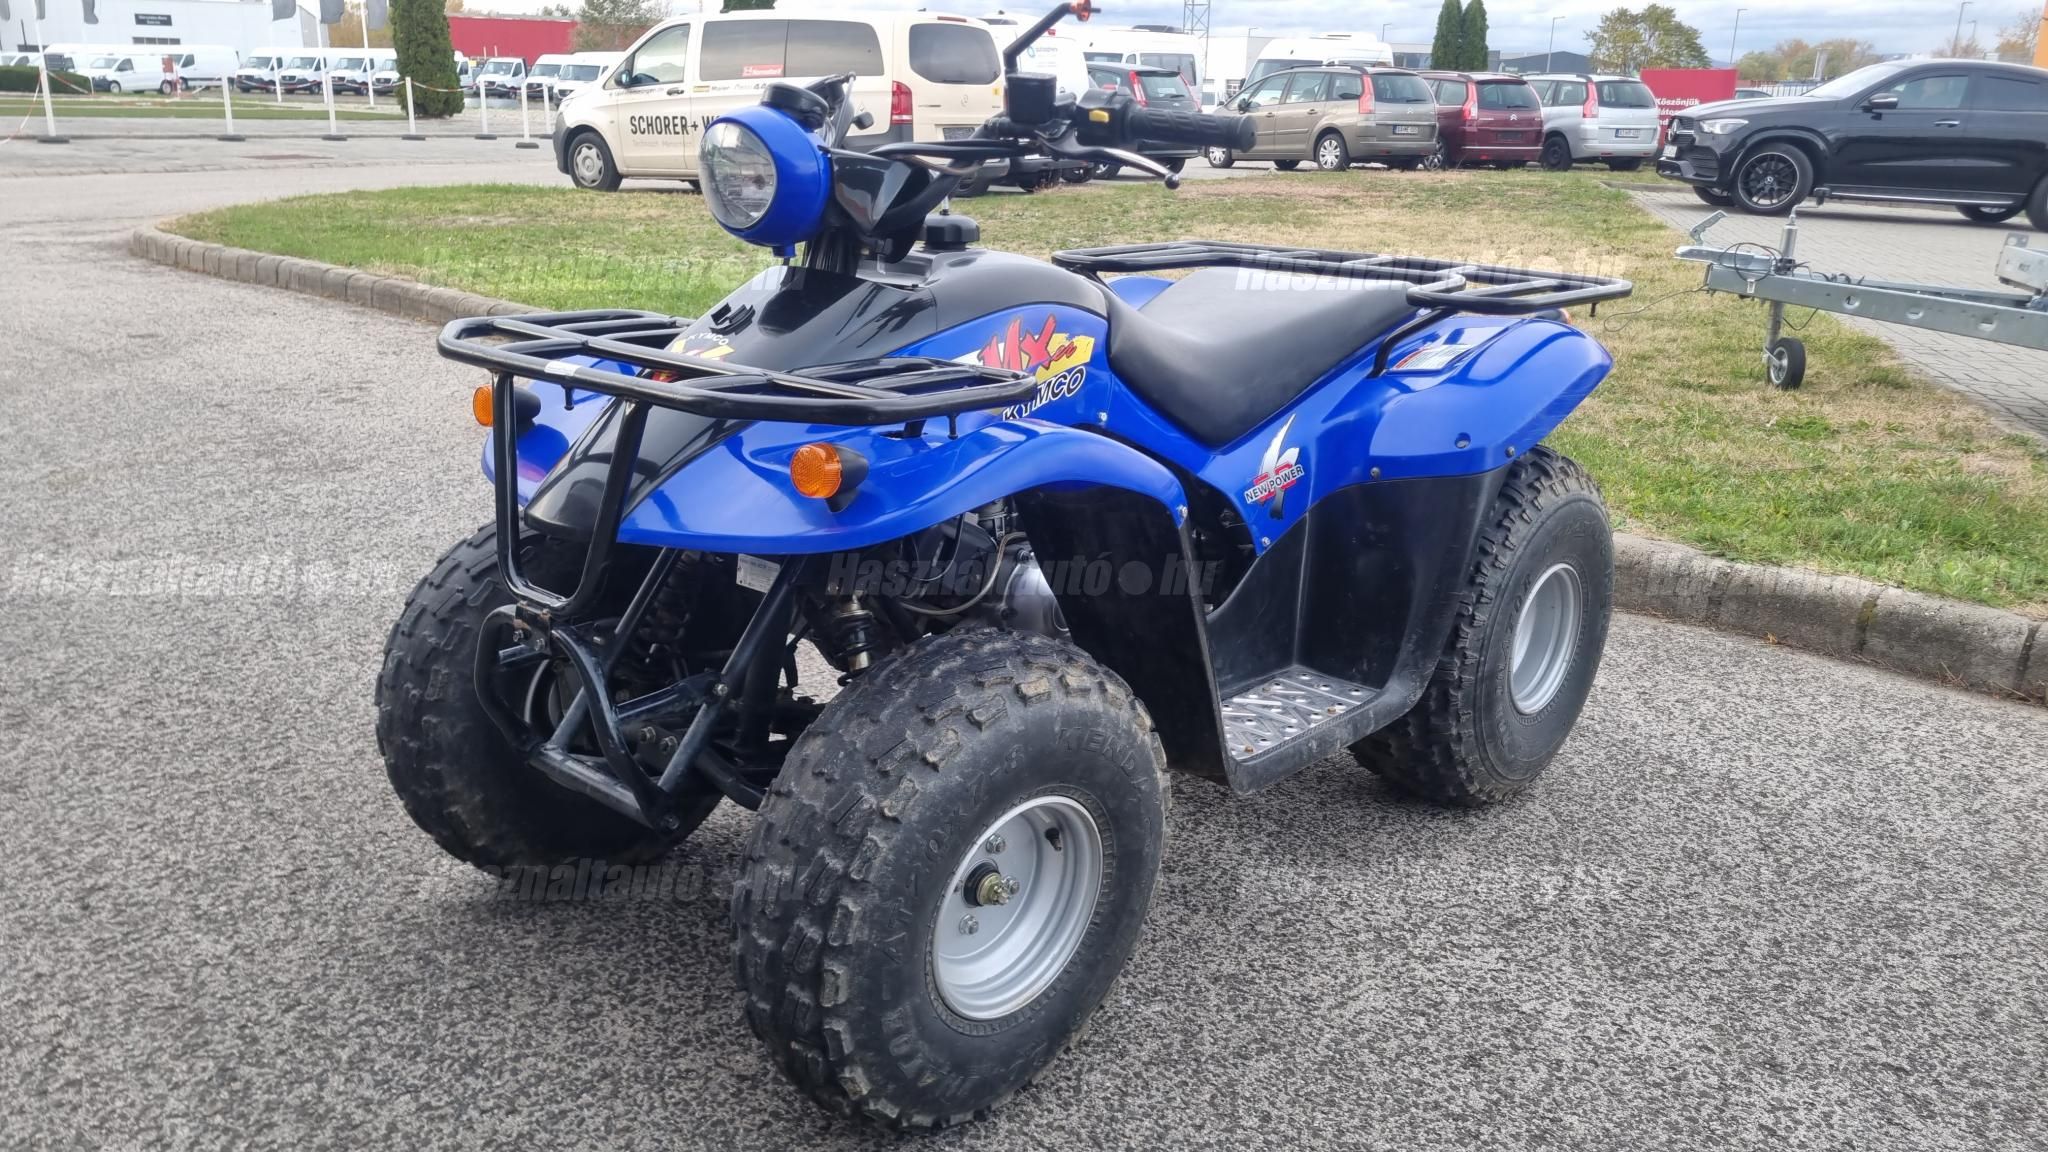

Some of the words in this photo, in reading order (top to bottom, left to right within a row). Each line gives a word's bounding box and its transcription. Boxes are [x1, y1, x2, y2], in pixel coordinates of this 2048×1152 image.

[1002, 365, 1087, 421] KYMCO
[1244, 481, 1269, 502] NEW
[1267, 465, 1304, 493] POWER
